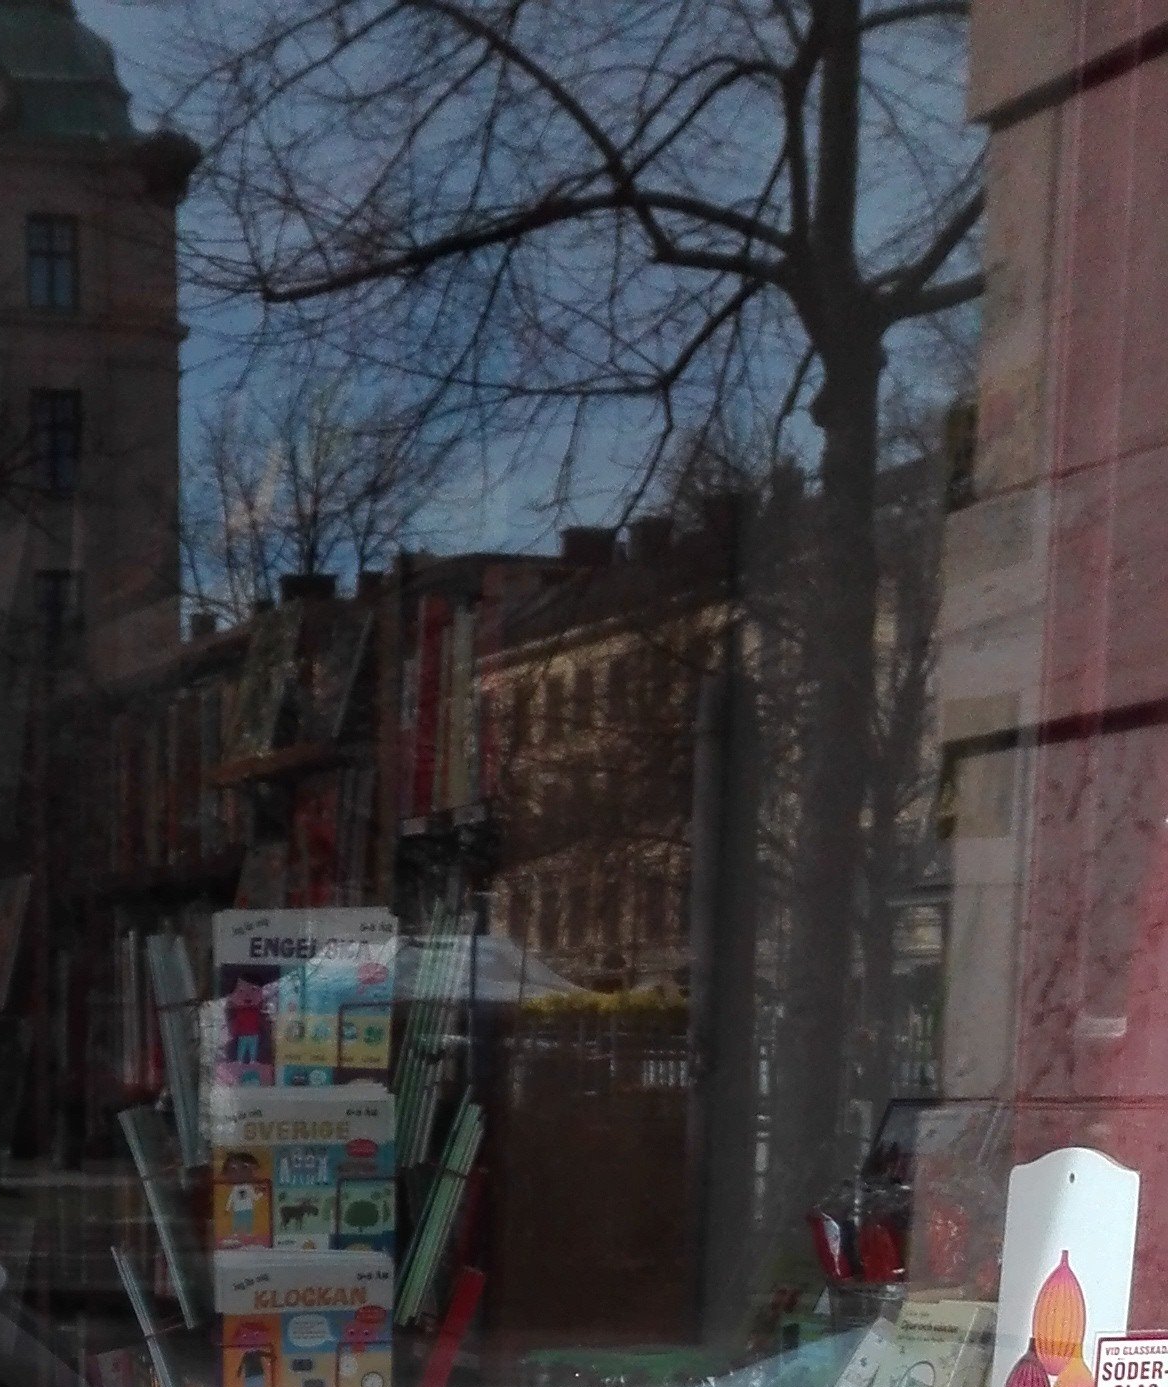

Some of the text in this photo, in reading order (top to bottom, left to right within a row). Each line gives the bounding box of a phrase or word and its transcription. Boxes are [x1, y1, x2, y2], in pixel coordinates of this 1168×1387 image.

[243, 1119, 350, 1141] SVERIGE
[253, 1285, 368, 1309] KLOCKAN
[1122, 1345, 1168, 1356] GLASSKAD
[1101, 1357, 1168, 1381] SÖDER-
